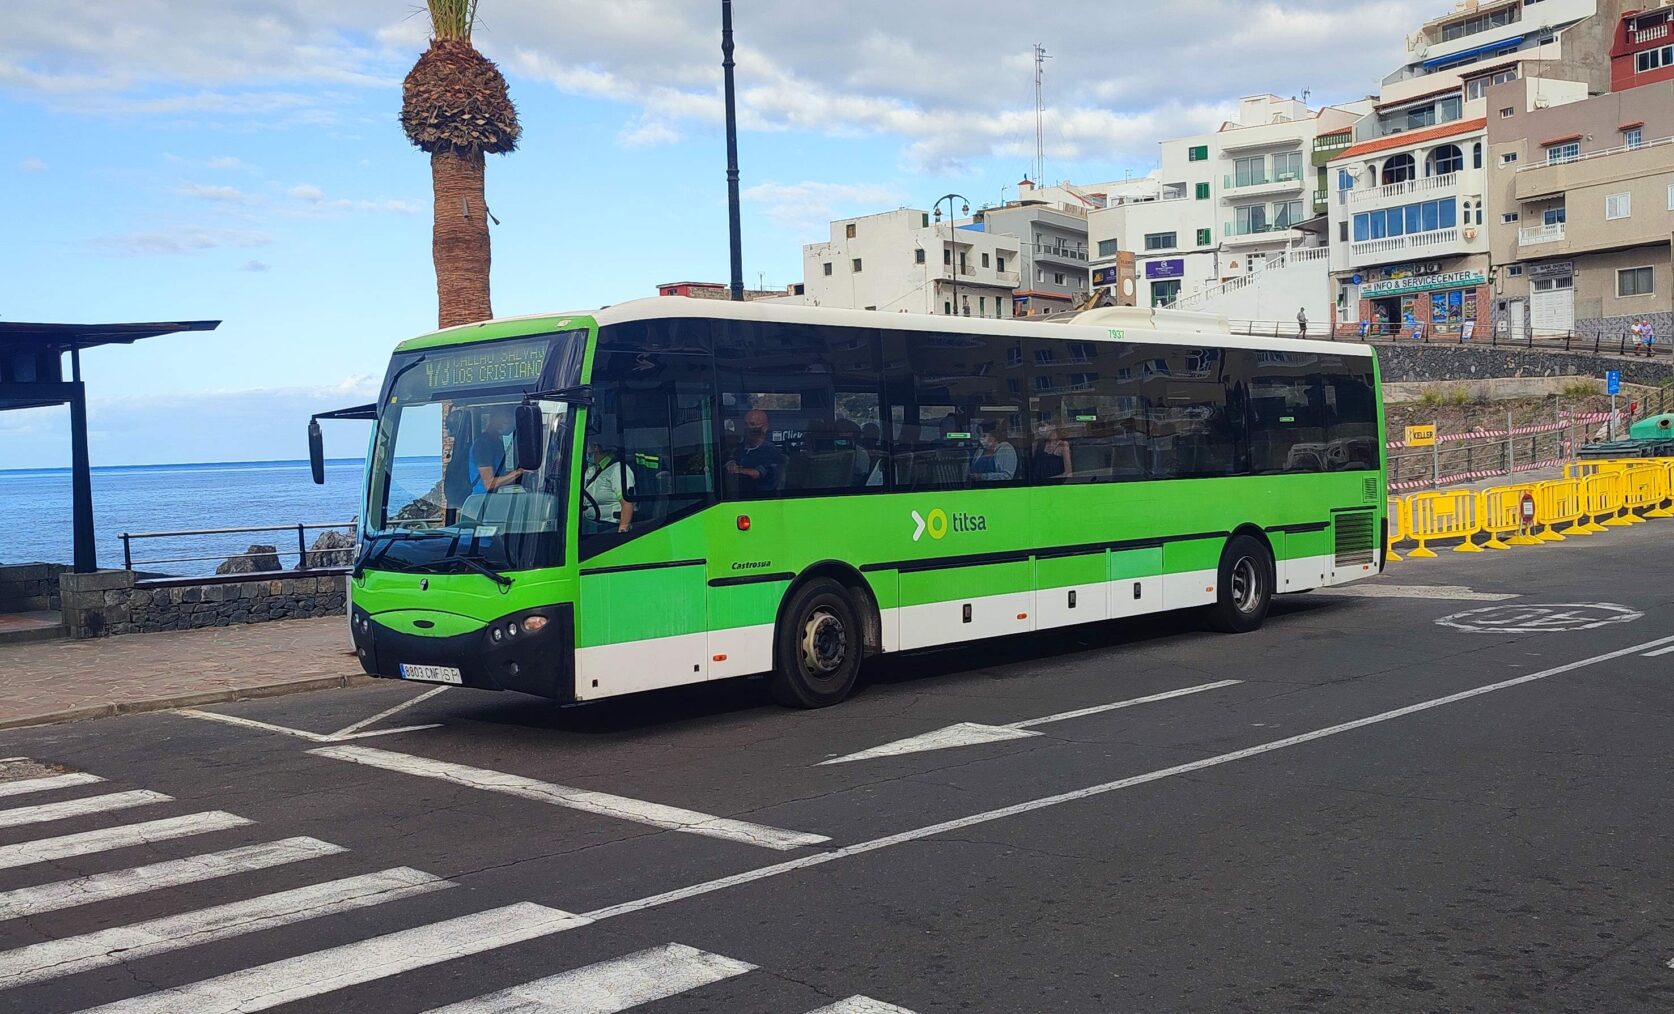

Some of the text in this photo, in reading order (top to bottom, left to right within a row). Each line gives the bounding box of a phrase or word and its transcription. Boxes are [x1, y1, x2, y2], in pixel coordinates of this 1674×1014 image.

[1402, 270, 1472, 288] SERVICECENTER
[1108, 329, 1125, 340] 7937
[453, 367, 473, 385] LOS
[1413, 431, 1433, 440] KELLER
[953, 512, 987, 532] titsa
[731, 560, 772, 570] Castrosua
[406, 666, 424, 679] 8803
